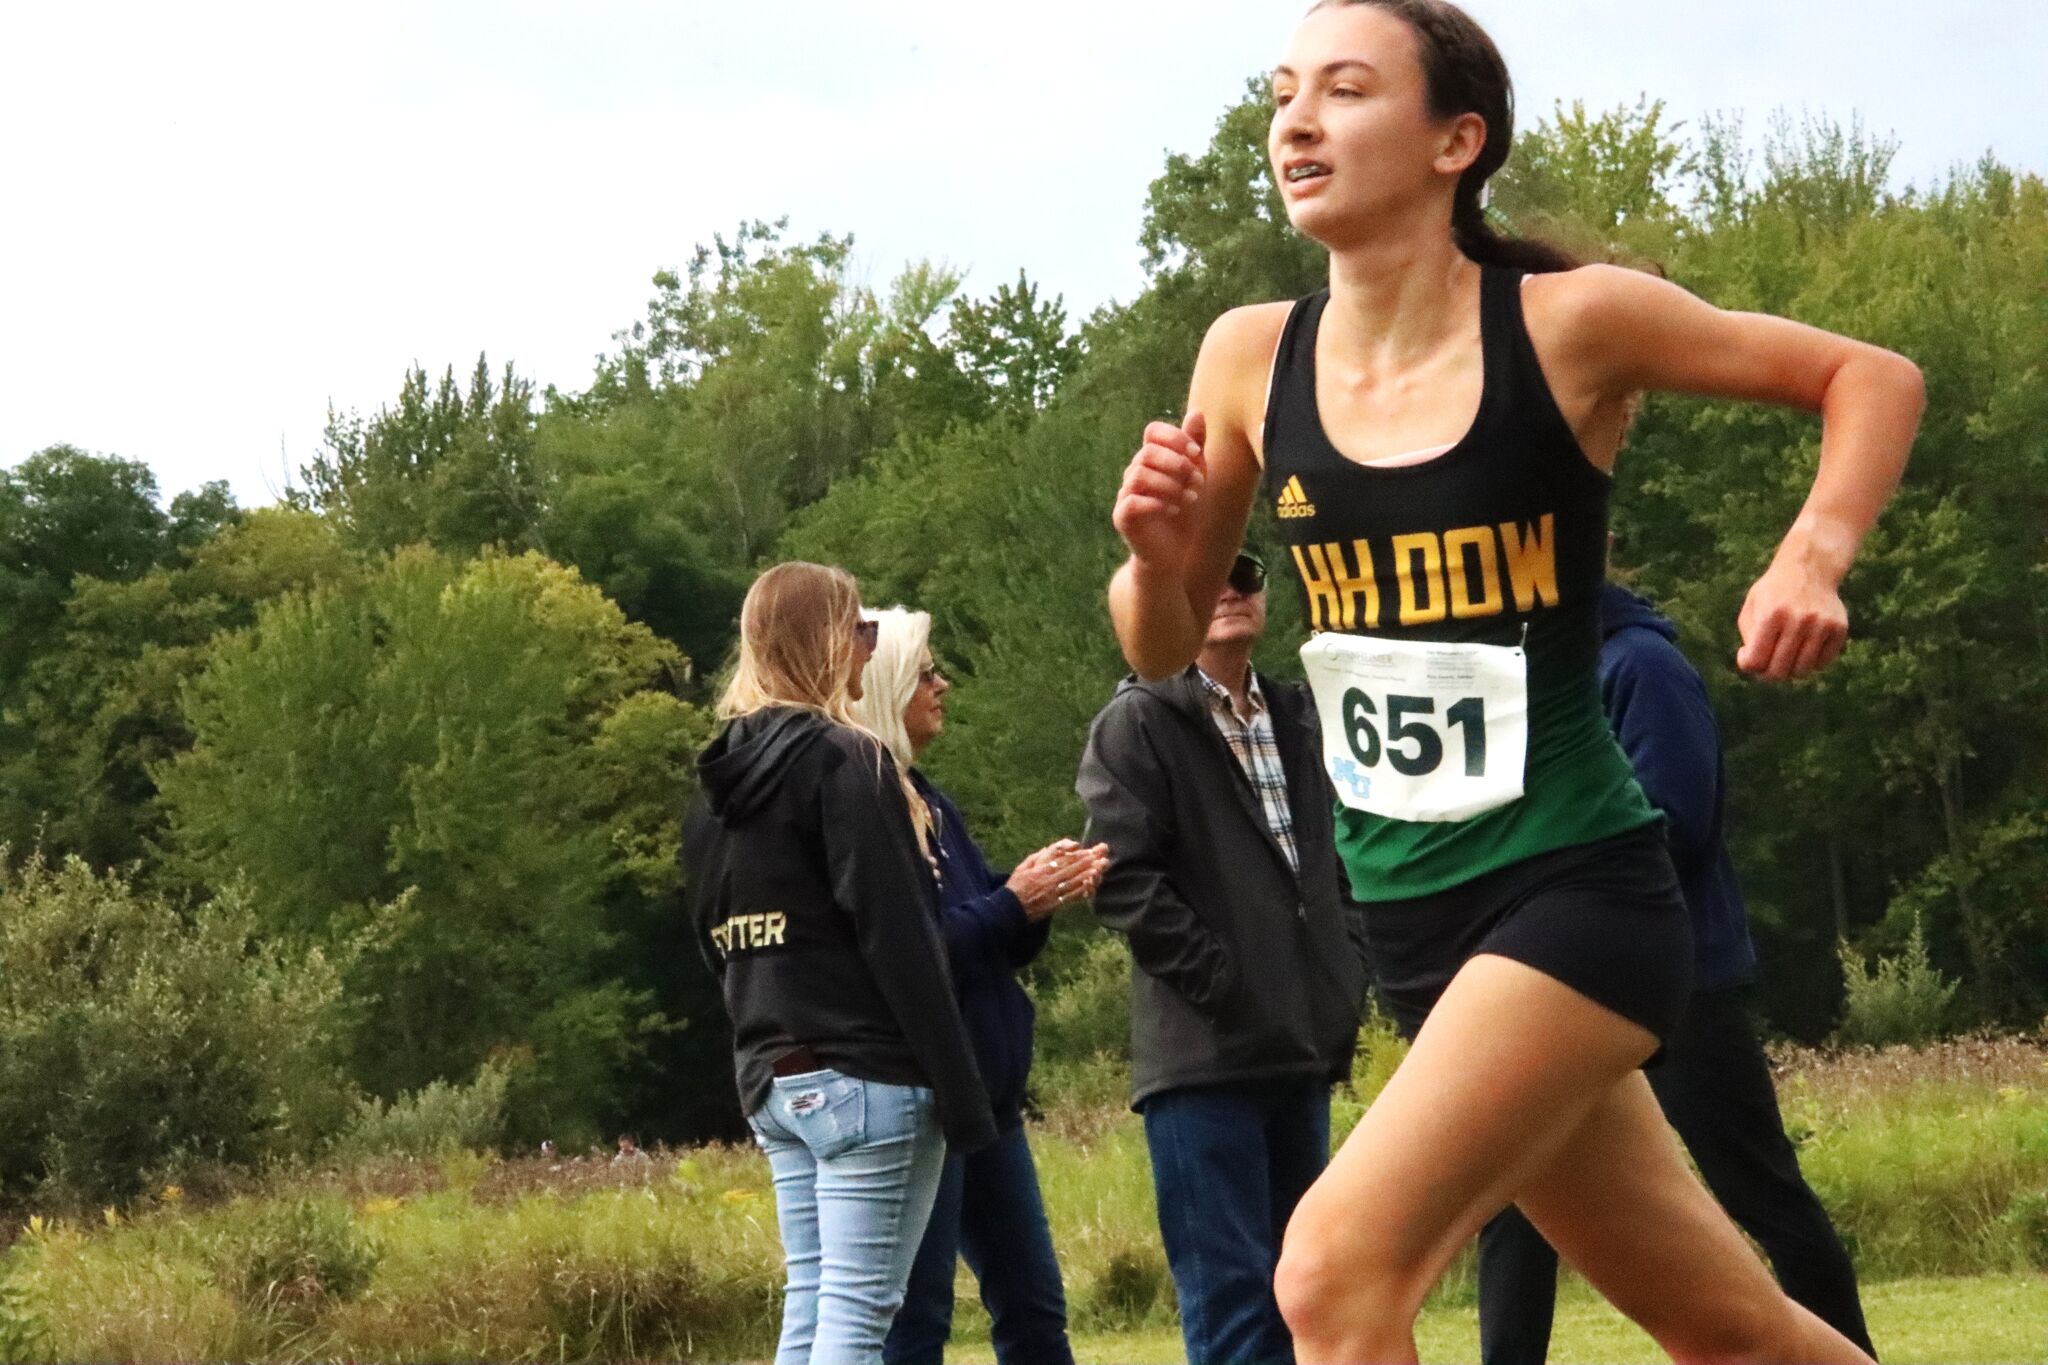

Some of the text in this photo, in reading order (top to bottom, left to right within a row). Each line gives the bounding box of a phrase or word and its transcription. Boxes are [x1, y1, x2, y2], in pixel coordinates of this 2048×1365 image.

[1291, 512, 1559, 631] HH DOW
[1342, 686, 1486, 777] 651
